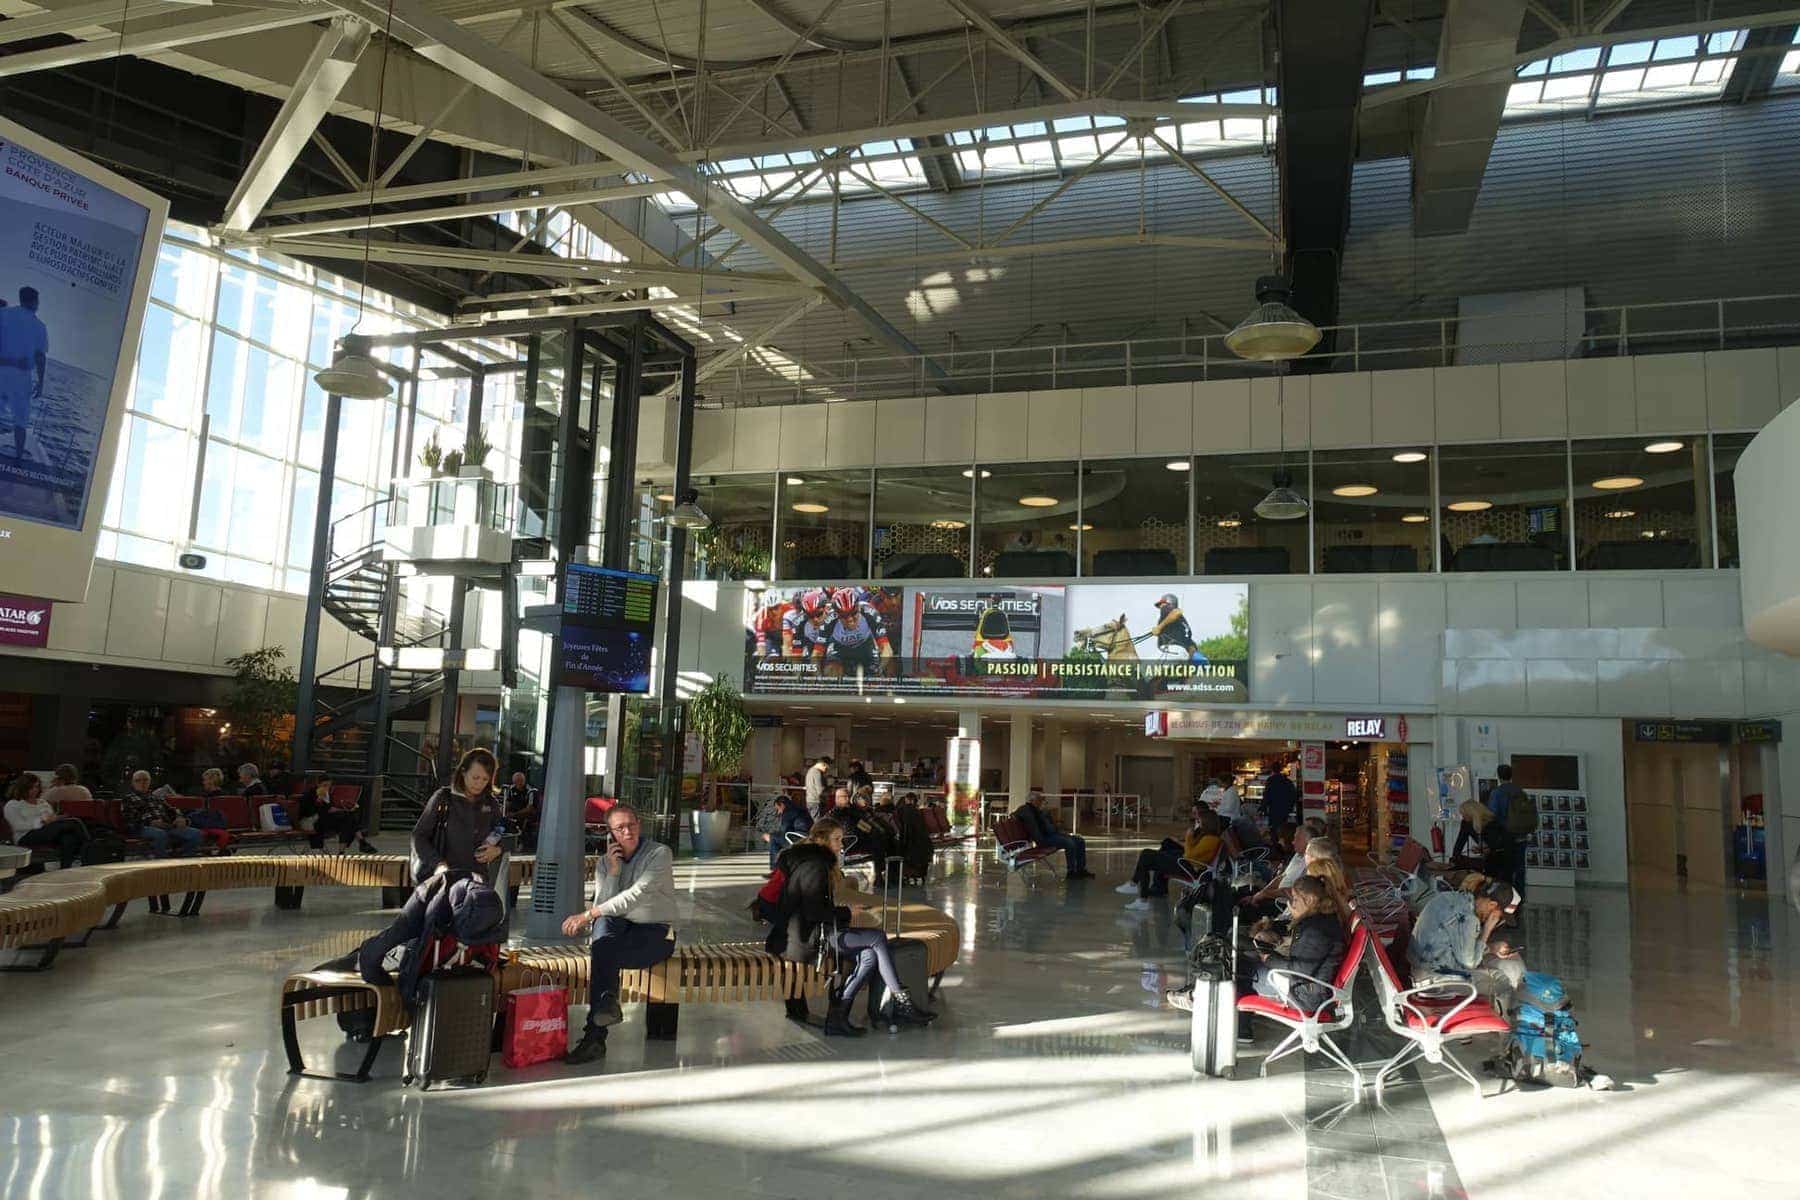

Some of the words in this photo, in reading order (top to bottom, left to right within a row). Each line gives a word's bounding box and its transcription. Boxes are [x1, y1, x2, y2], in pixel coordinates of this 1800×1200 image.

[6, 167, 50, 193] BANQUE
[0, 607, 26, 620] ATAR
[775, 663, 817, 671] SECURITIES
[988, 663, 1037, 675] PASSION
[1051, 664, 1132, 676] PERSISTANCE
[1145, 665, 1235, 677] ANTICIPATION
[1167, 682, 1234, 692] www.adss.com
